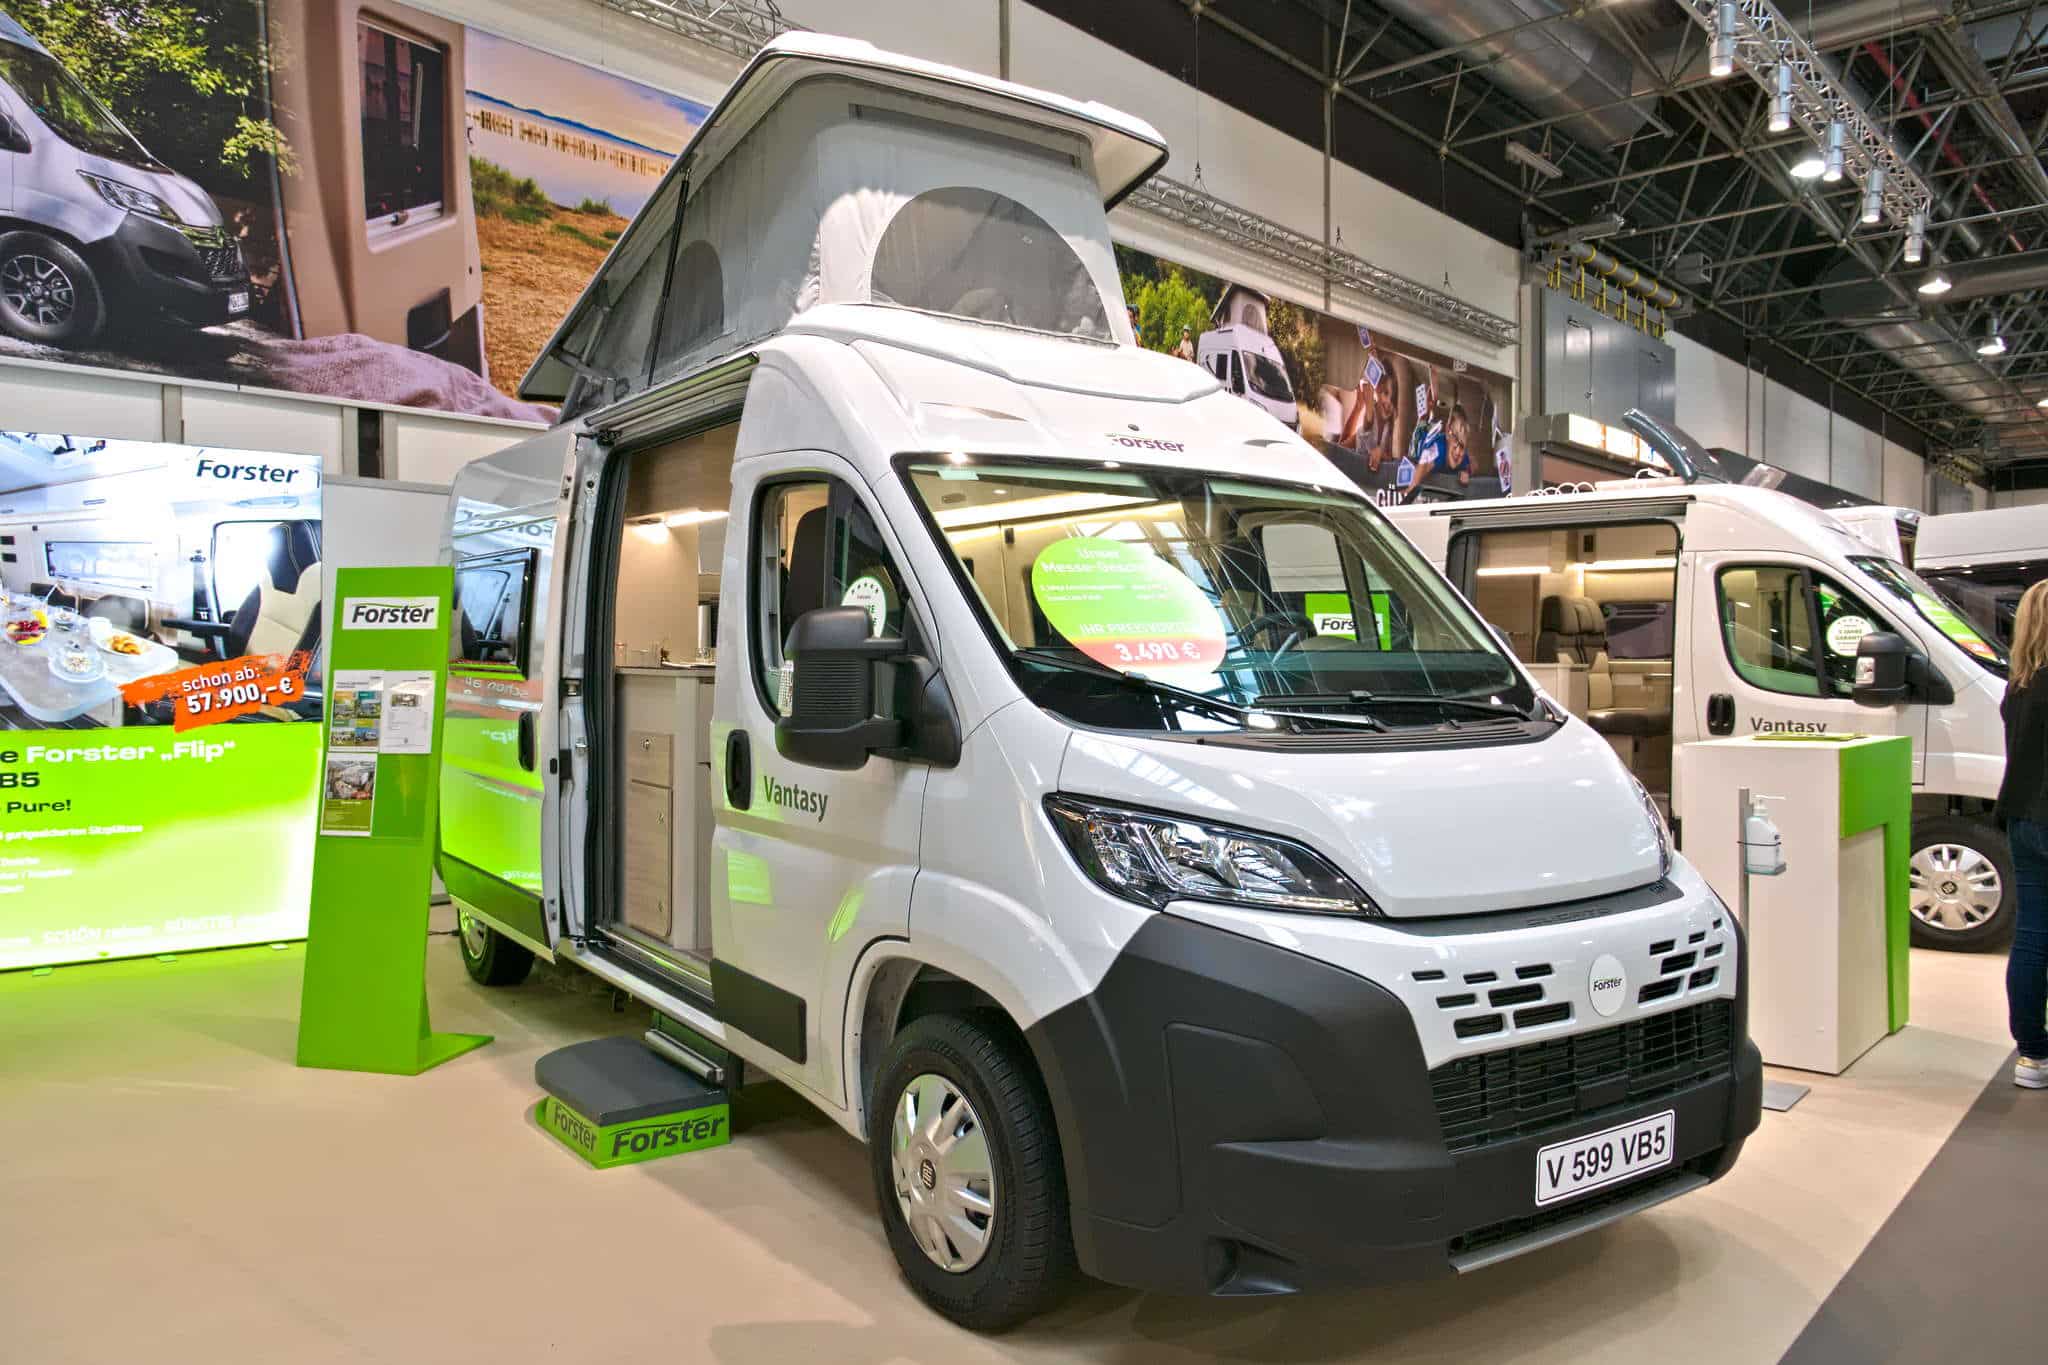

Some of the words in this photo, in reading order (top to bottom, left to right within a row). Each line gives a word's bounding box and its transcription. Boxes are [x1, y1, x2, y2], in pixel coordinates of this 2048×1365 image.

[196, 459, 300, 483] Forster
[352, 605, 434, 623] Forster
[1115, 642, 1179, 662] 3.490
[1181, 642, 1201, 659] €
[182, 672, 232, 692] schon
[235, 665, 261, 681] ab:
[26, 745, 155, 764] Forster
[7, 799, 71, 814] Pure!
[763, 775, 828, 823] Vantasy
[1593, 978, 1622, 991] Forster
[553, 1102, 597, 1152] Forster
[611, 1117, 726, 1158] Forster
[1546, 1155, 1565, 1188] V
[1572, 1142, 1613, 1181] 599
[1621, 1126, 1665, 1165] VB5
